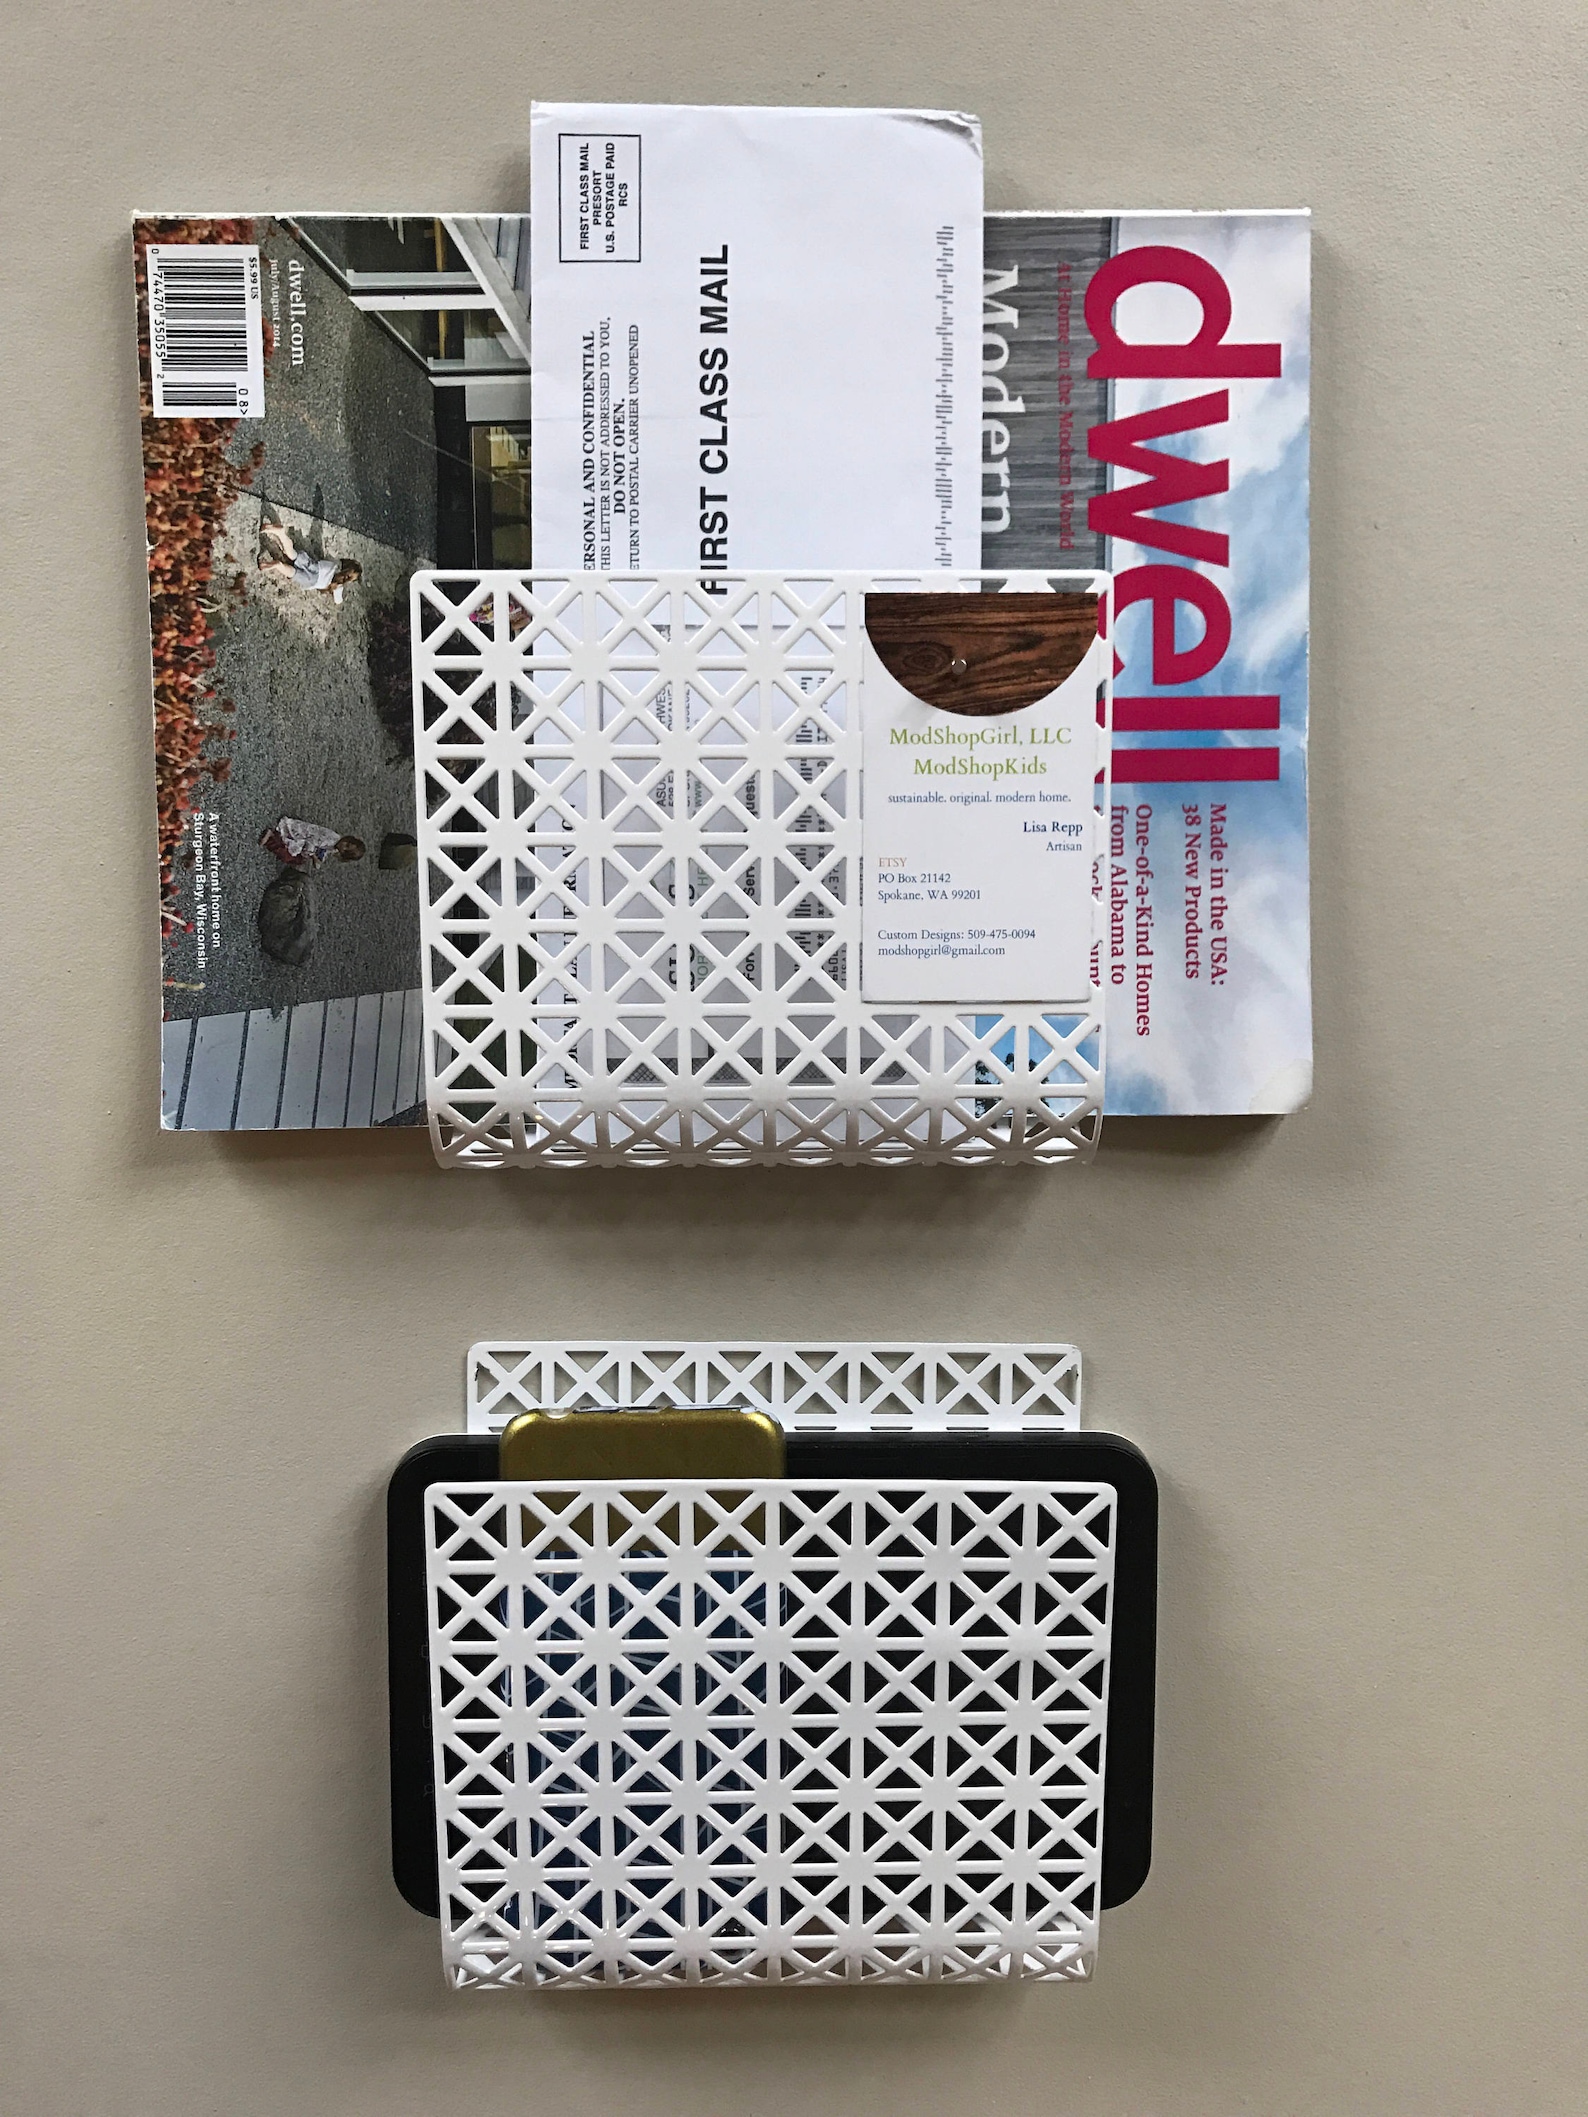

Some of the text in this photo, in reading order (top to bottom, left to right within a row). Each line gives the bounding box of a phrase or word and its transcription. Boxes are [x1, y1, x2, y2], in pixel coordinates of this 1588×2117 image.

[580, 143, 589, 250] FIRST CLASS MAIL
[592, 170, 602, 225] PRESORT
[605, 142, 615, 253] U.S. POSTAGE PAID
[618, 182, 628, 207] RCS
[153, 272, 165, 311] 74470
[249, 257, 259, 299] $5.99 US
[289, 259, 306, 366] dwell.com
[600, 317, 611, 349] YOU.
[1057, 287, 1071, 345] Home
[154, 319, 166, 358] 35055
[600, 352, 610, 369] TO
[1058, 351, 1073, 369] in
[600, 372, 610, 447] ADDRESSED
[982, 264, 1026, 533] Modern
[1058, 374, 1074, 405] the
[700, 244, 728, 596] FIRST CLASS MAIL
[583, 331, 595, 570] ERSONAL AND CONFIDENTIAL
[600, 450, 610, 476] NOT
[613, 398, 625, 514] DO NOT OPEN.
[629, 324, 640, 570] ETURN TO POSTAL CARRIER UNOPENED
[1059, 411, 1075, 486] Modern
[600, 480, 610, 491] IS
[600, 495, 610, 542] LETTER
[1059, 491, 1075, 550] World
[1084, 245, 1282, 783] dwell
[889, 725, 1072, 751] ModShopGirl, LLC
[914, 755, 1048, 781] ModShopKids
[888, 790, 1072, 806] sustainable. original. modern home.
[1023, 821, 1083, 837] Lisa Repp
[1046, 841, 1082, 852] Artisan
[209, 812, 222, 948] A waterfront home on
[878, 857, 908, 868] ETSY
[878, 873, 951, 884] PO Box 21142
[193, 812, 208, 969] Sturgeon Bay, Wisconsin
[878, 889, 981, 903] Spokane, WA 99201
[1110, 805, 1129, 985] from Alabama to
[1182, 803, 1203, 979] 38 New Products
[1210, 803, 1229, 986] Made in the USA:
[878, 928, 1036, 942] Custom Designs: 509-475-0094
[1136, 804, 1154, 1037] One-of-a-Kind Homes
[878, 944, 1006, 959] modshopgirl@gmail.com
